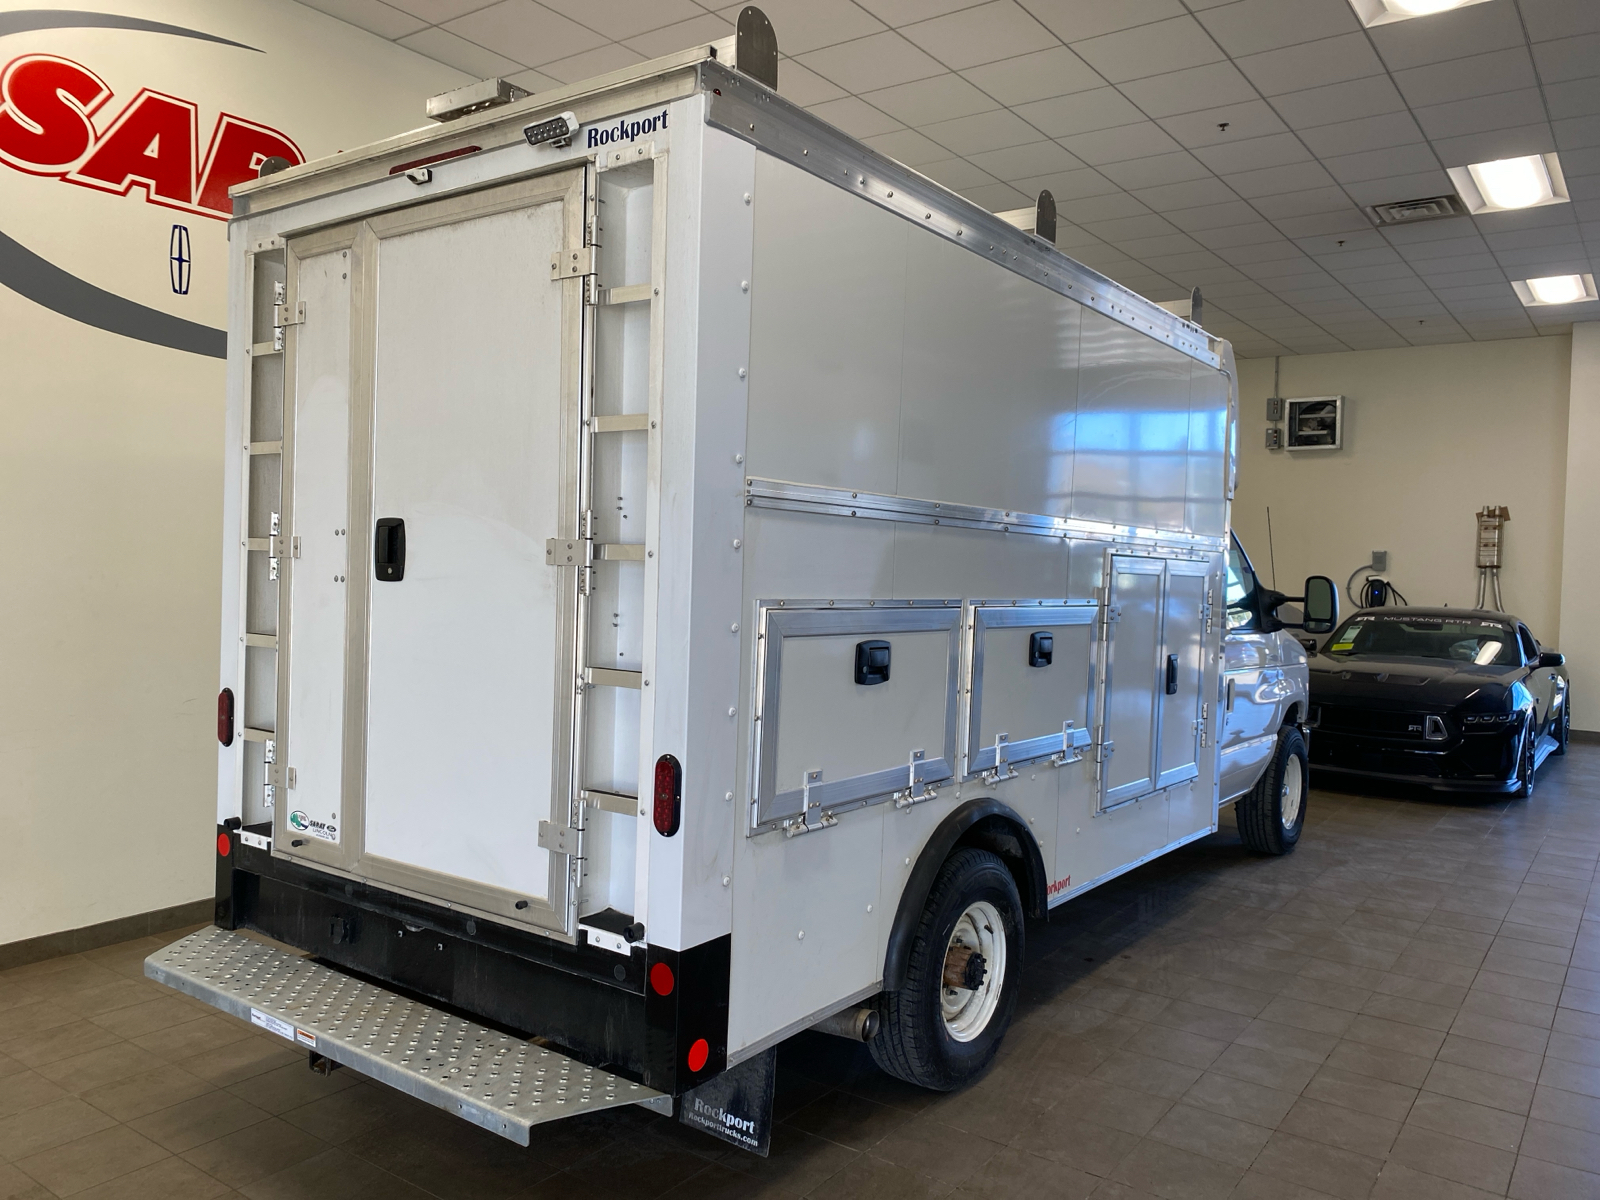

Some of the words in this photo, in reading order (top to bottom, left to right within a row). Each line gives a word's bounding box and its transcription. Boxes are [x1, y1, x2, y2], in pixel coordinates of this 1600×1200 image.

[587, 109, 668, 149] Rockport
[1047, 874, 1071, 895] ockport
[688, 1111, 758, 1147] Rockporttrucks.com
[693, 1097, 755, 1134] Rockport
